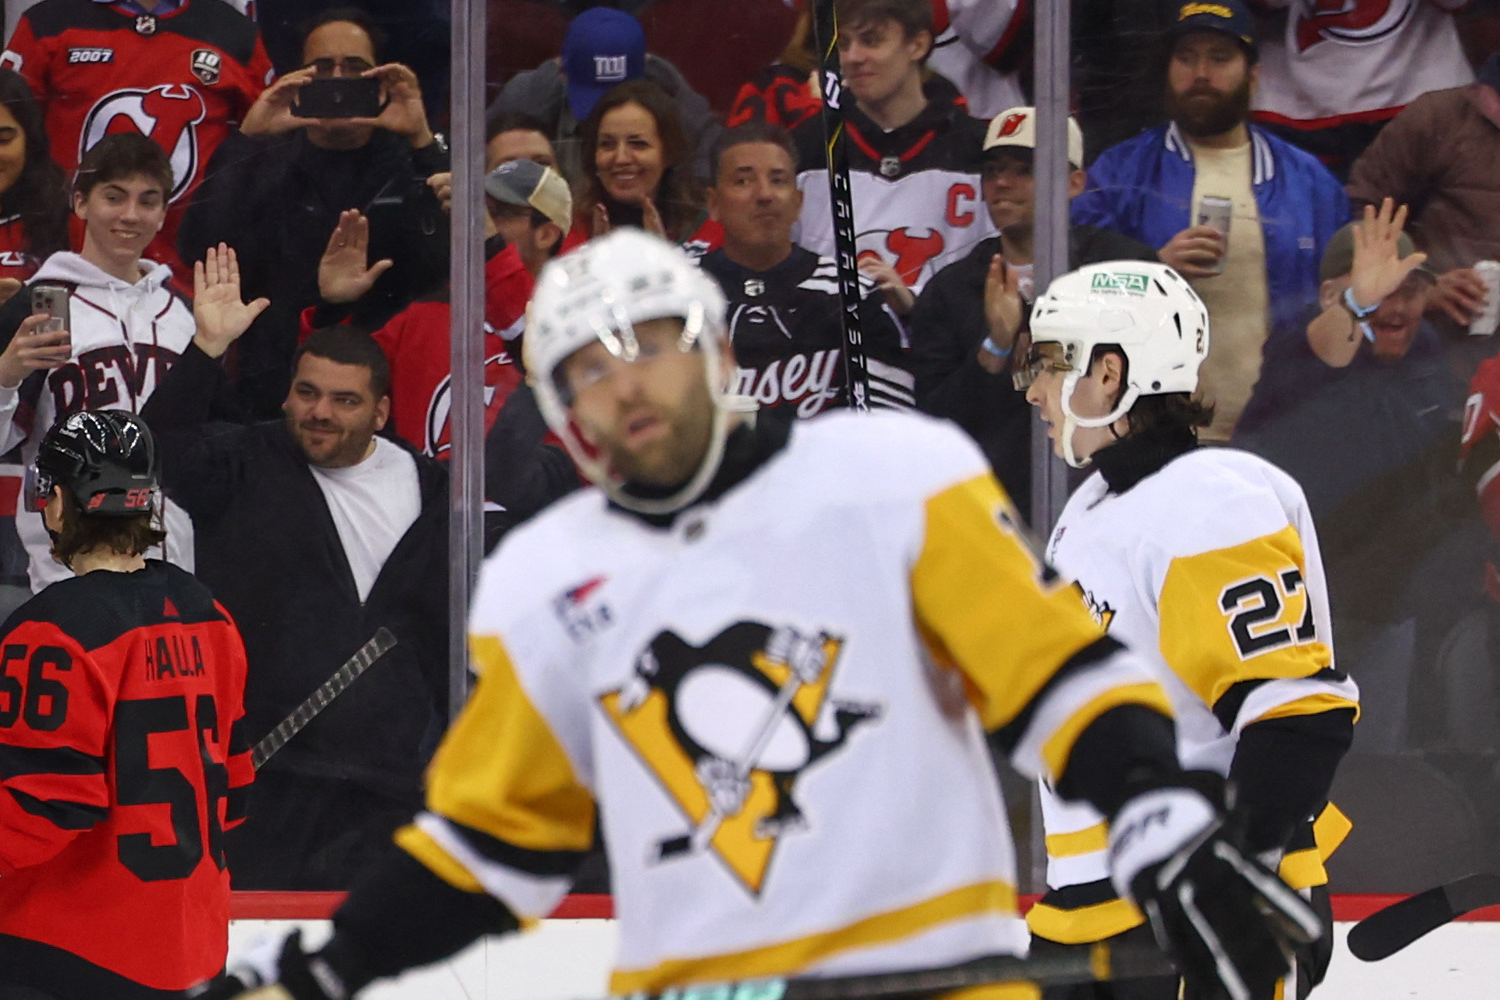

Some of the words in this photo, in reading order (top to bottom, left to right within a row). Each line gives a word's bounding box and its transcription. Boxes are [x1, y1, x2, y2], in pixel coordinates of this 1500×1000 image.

[69, 50, 112, 63] 2007
[197, 52, 219, 67] 10
[947, 184, 974, 226] C
[1094, 273, 1145, 291] MSA
[124, 489, 150, 507] 56
[1219, 568, 1317, 661] 27
